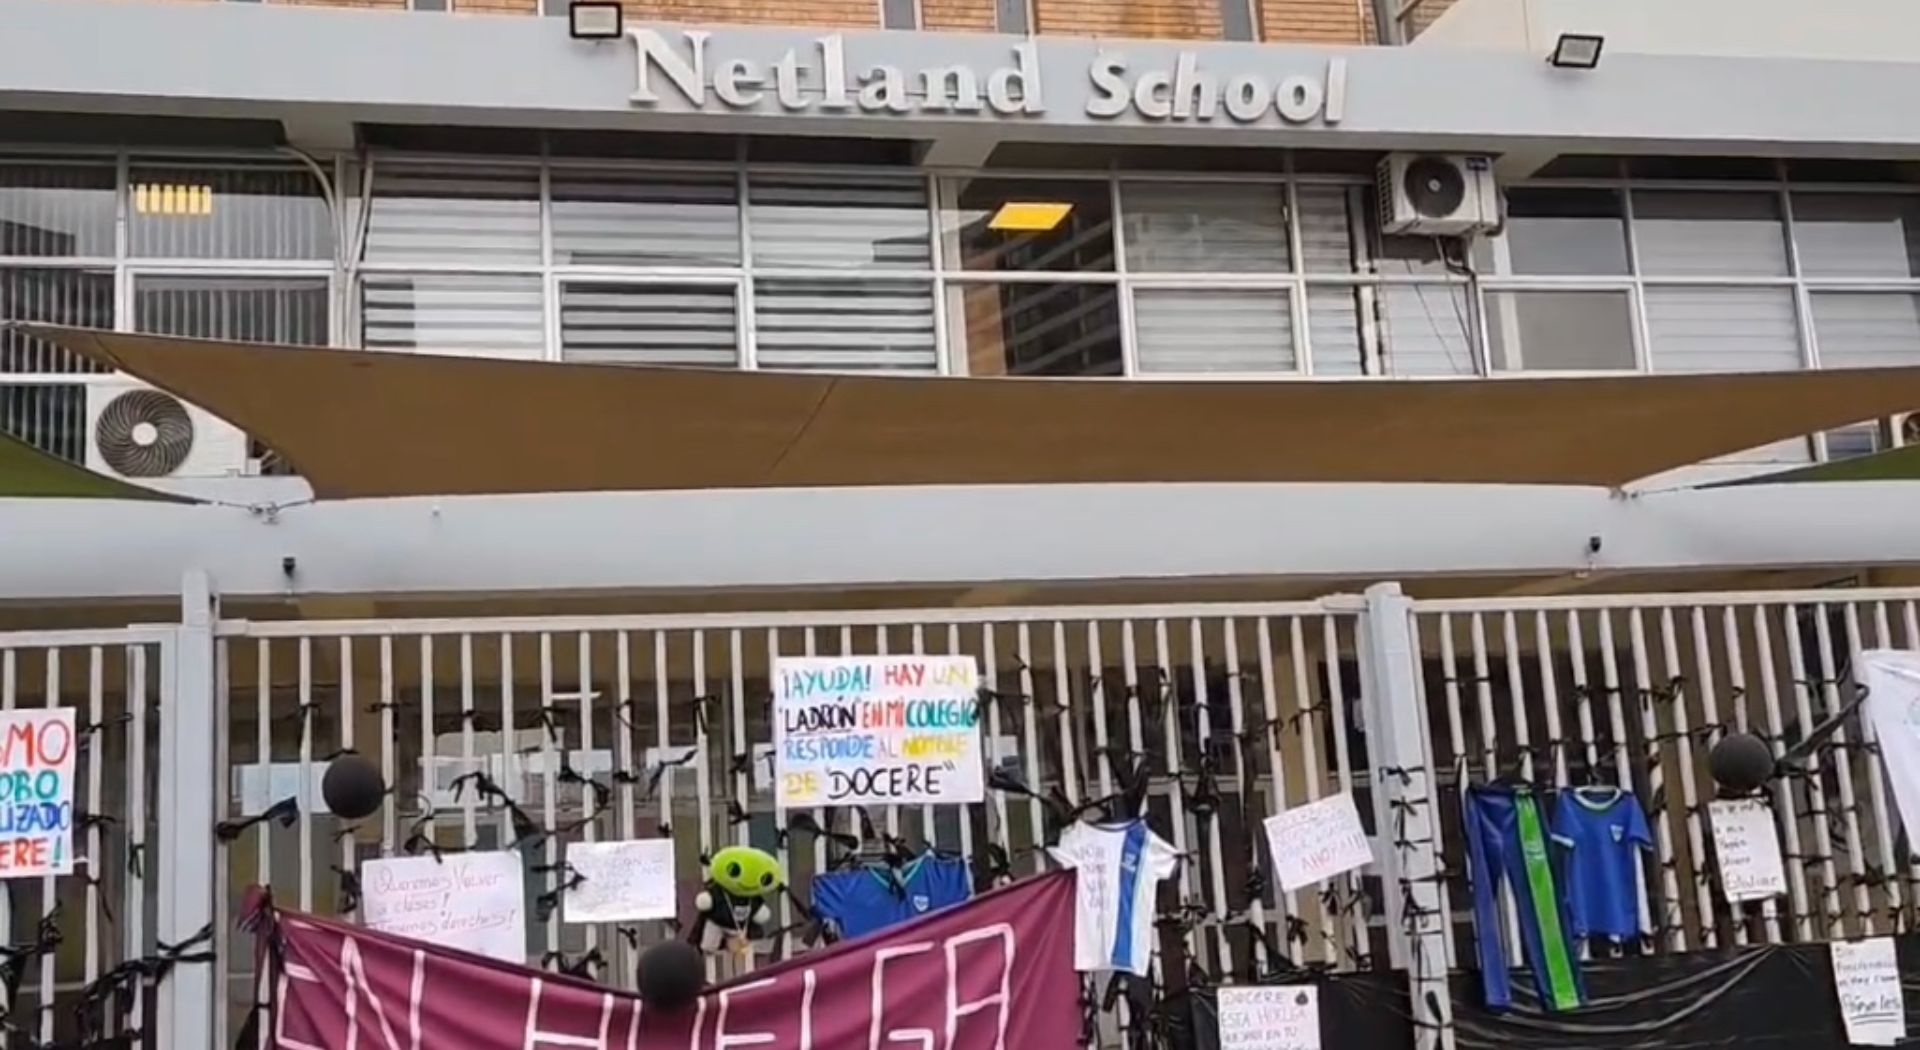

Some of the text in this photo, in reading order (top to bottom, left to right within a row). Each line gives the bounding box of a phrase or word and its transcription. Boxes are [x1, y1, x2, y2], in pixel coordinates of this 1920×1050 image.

[628, 29, 1347, 124] Netland School
[884, 663, 925, 687] HAY
[932, 666, 969, 686] UN
[863, 702, 883, 728] EN
[905, 699, 979, 728] COLEGIO
[784, 735, 874, 761] RESPONDE
[879, 739, 898, 759] AL
[783, 771, 817, 794] DE
